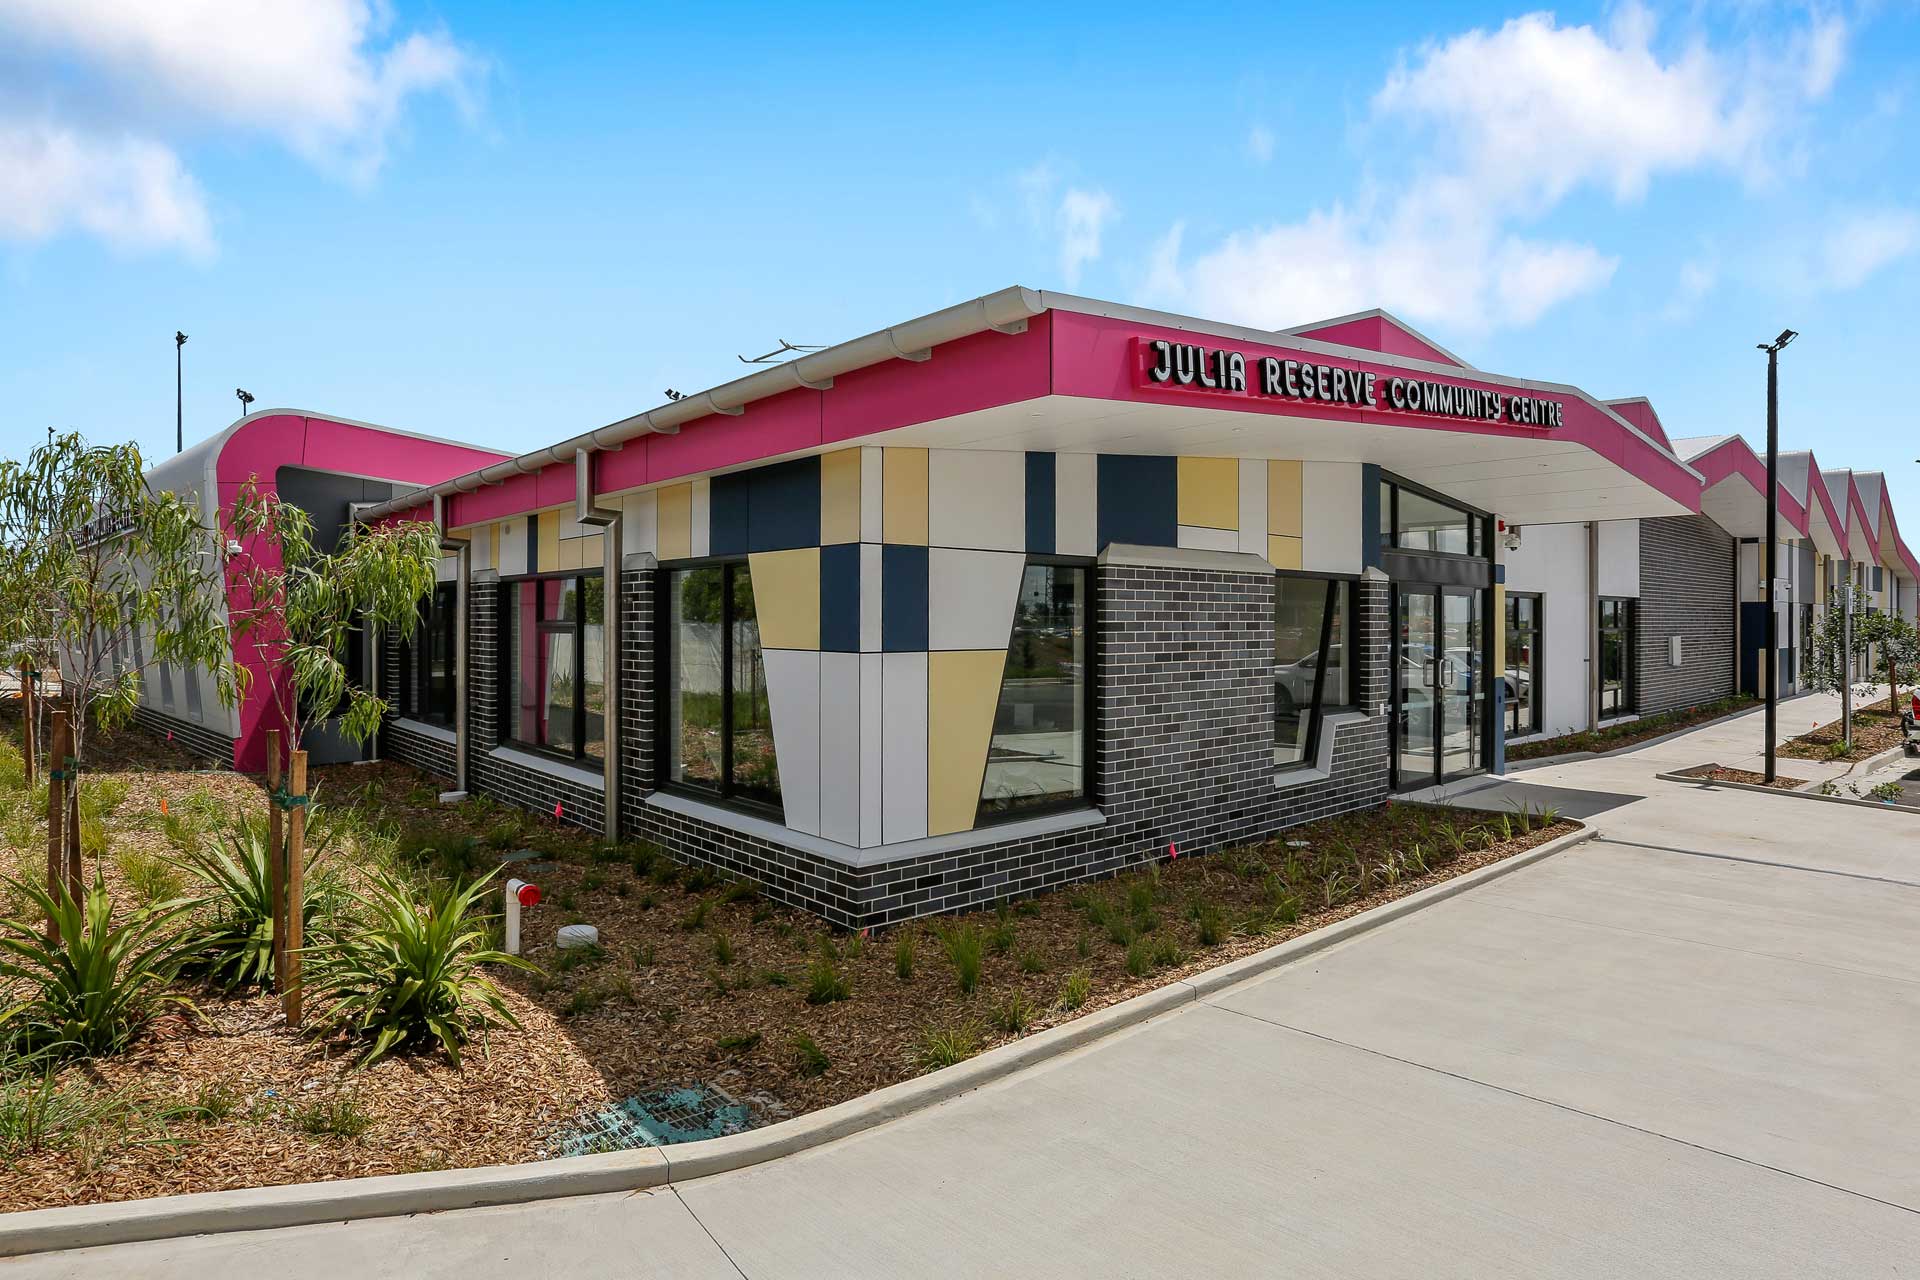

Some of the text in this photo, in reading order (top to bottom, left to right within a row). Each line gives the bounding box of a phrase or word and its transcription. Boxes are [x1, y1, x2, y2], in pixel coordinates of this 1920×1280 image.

[1151, 340, 1563, 427] JULIA RESERVE COMMUNITY CENTRE
